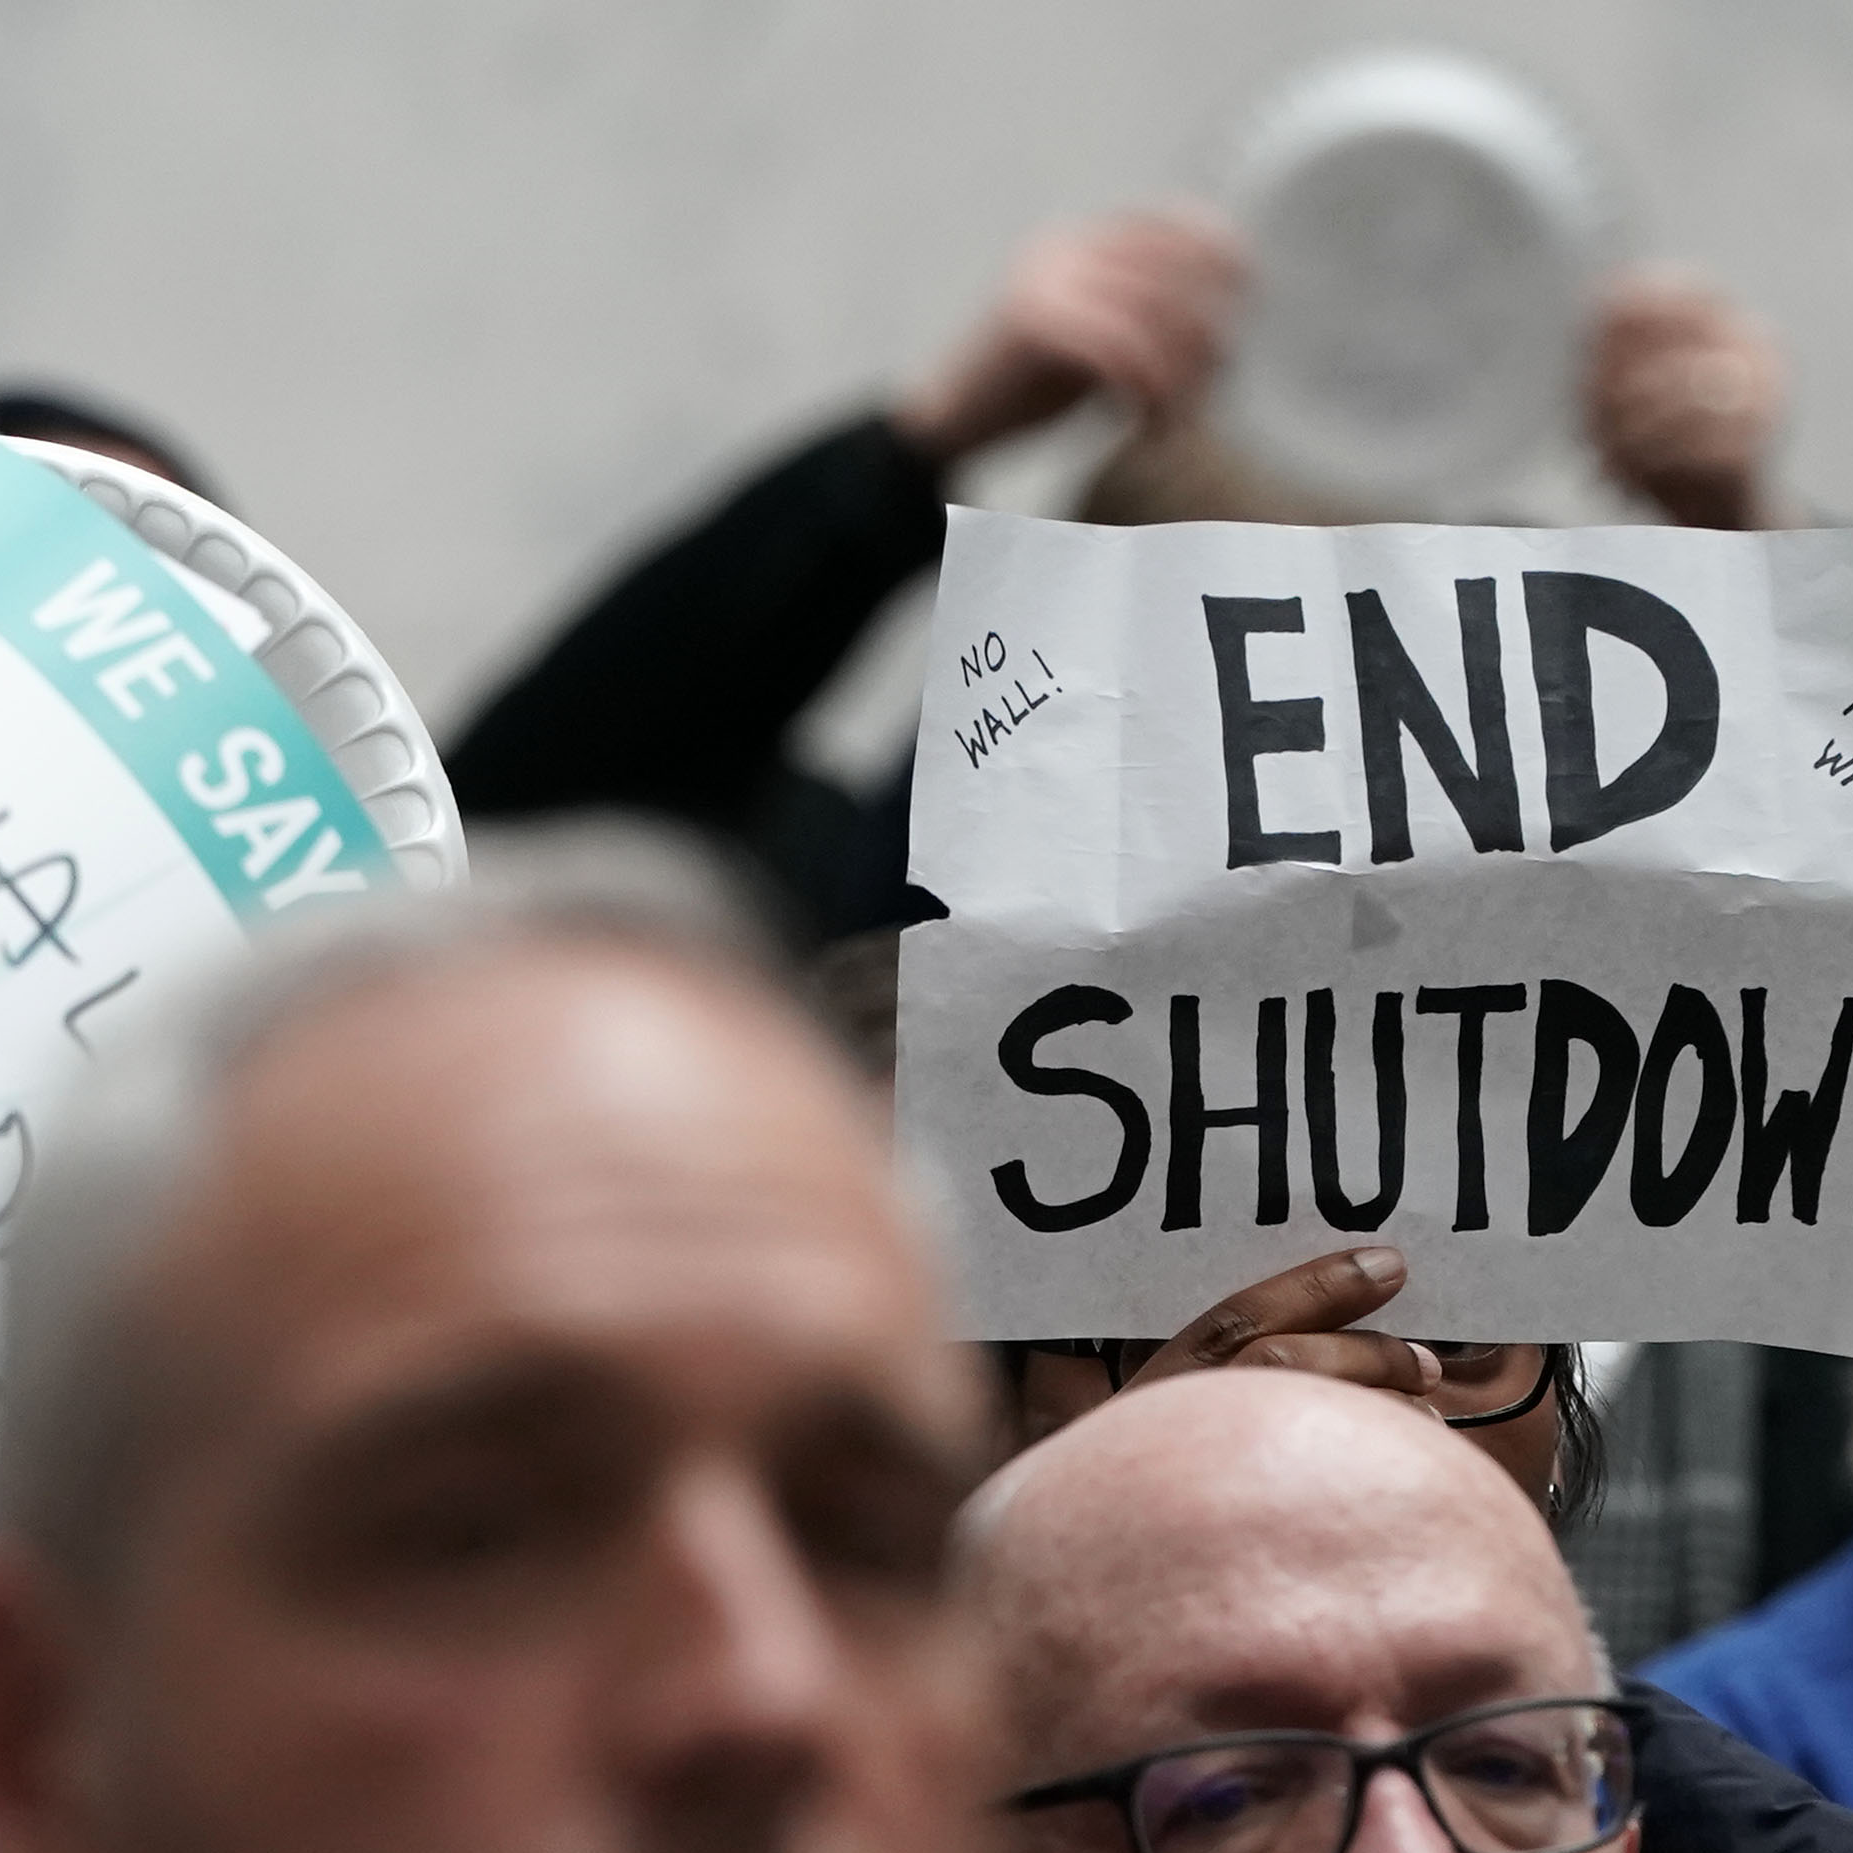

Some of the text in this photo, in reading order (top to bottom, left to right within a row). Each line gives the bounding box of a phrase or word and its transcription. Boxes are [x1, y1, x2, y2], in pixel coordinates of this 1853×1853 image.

[31, 557, 369, 914] WE SAY
[954, 648, 1063, 769] WALL!
[960, 631, 1006, 688] NO
[1200, 570, 1720, 869] END
